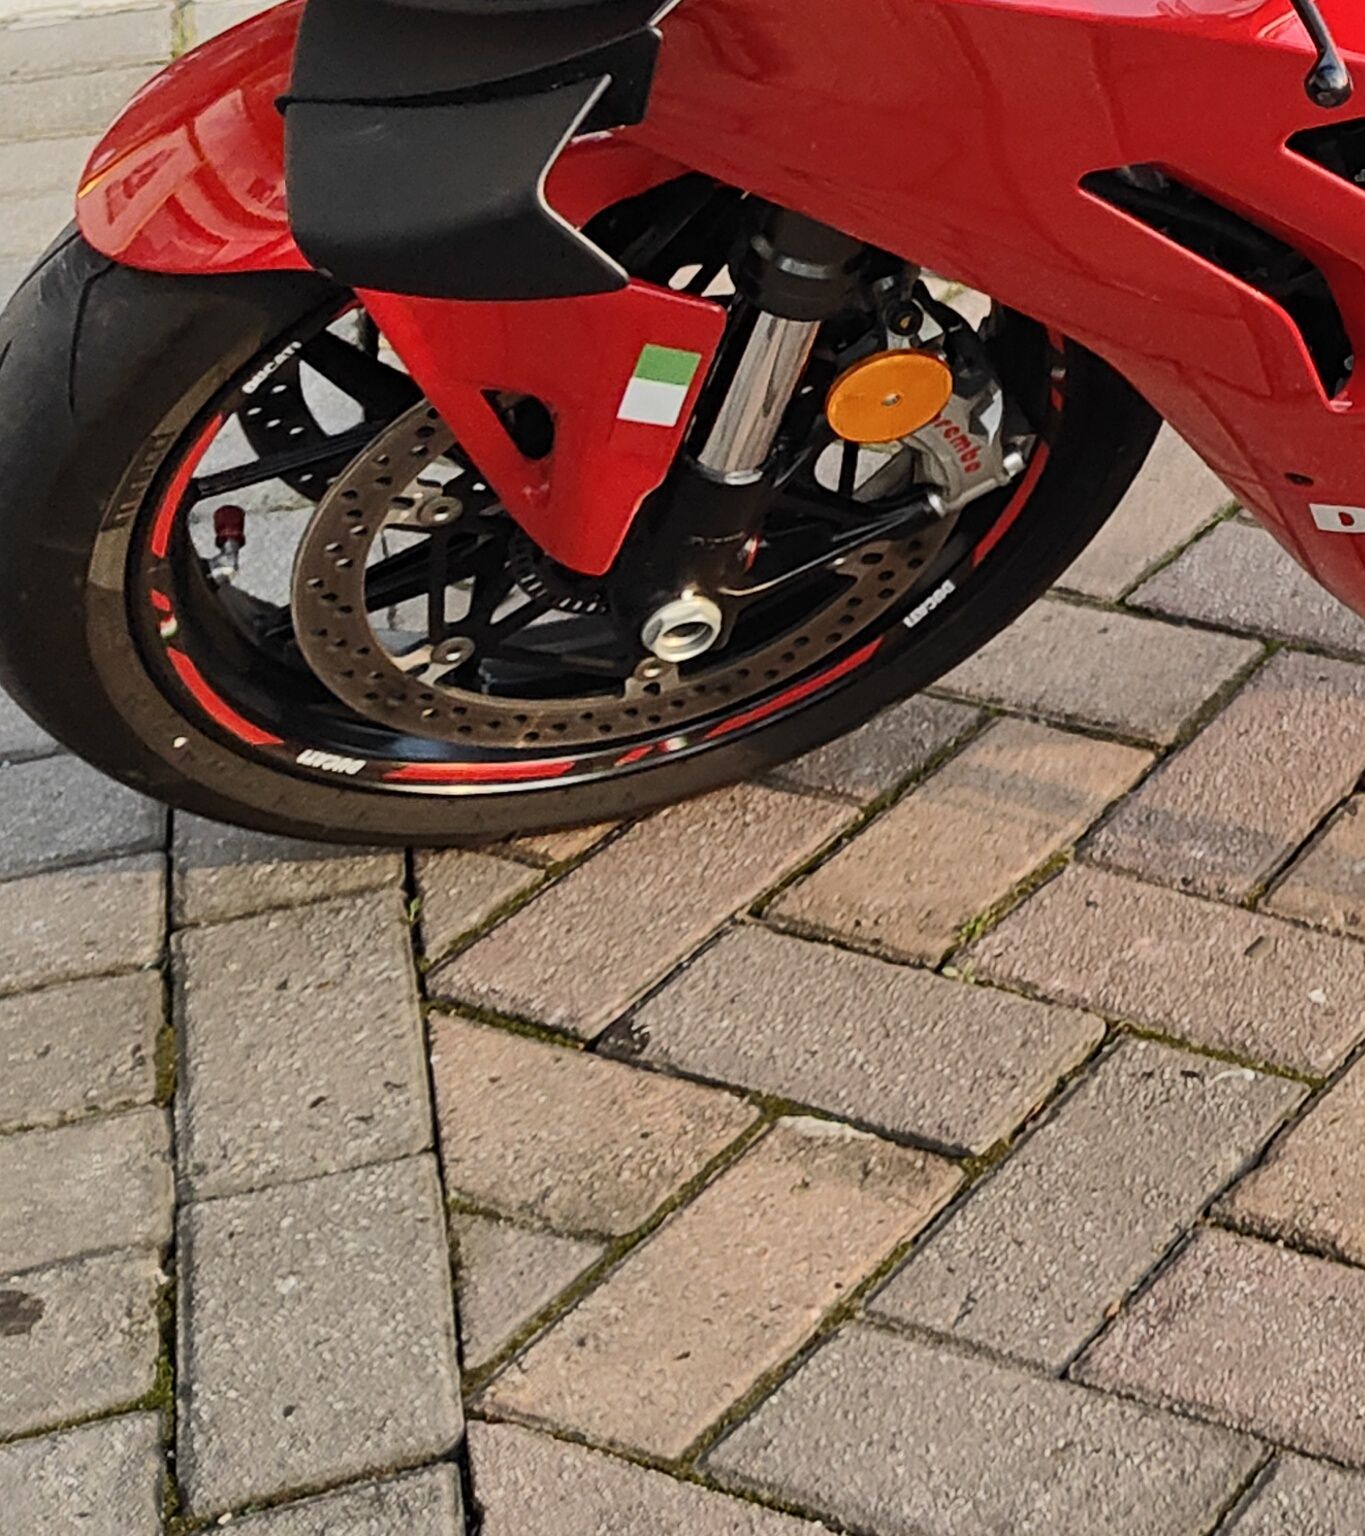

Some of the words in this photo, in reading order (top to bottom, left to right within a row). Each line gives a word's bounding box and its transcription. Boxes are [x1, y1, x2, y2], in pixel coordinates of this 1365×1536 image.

[241, 341, 302, 394] DUCATI
[902, 579, 956, 628] DUCATI
[296, 749, 368, 775] DUCATI
